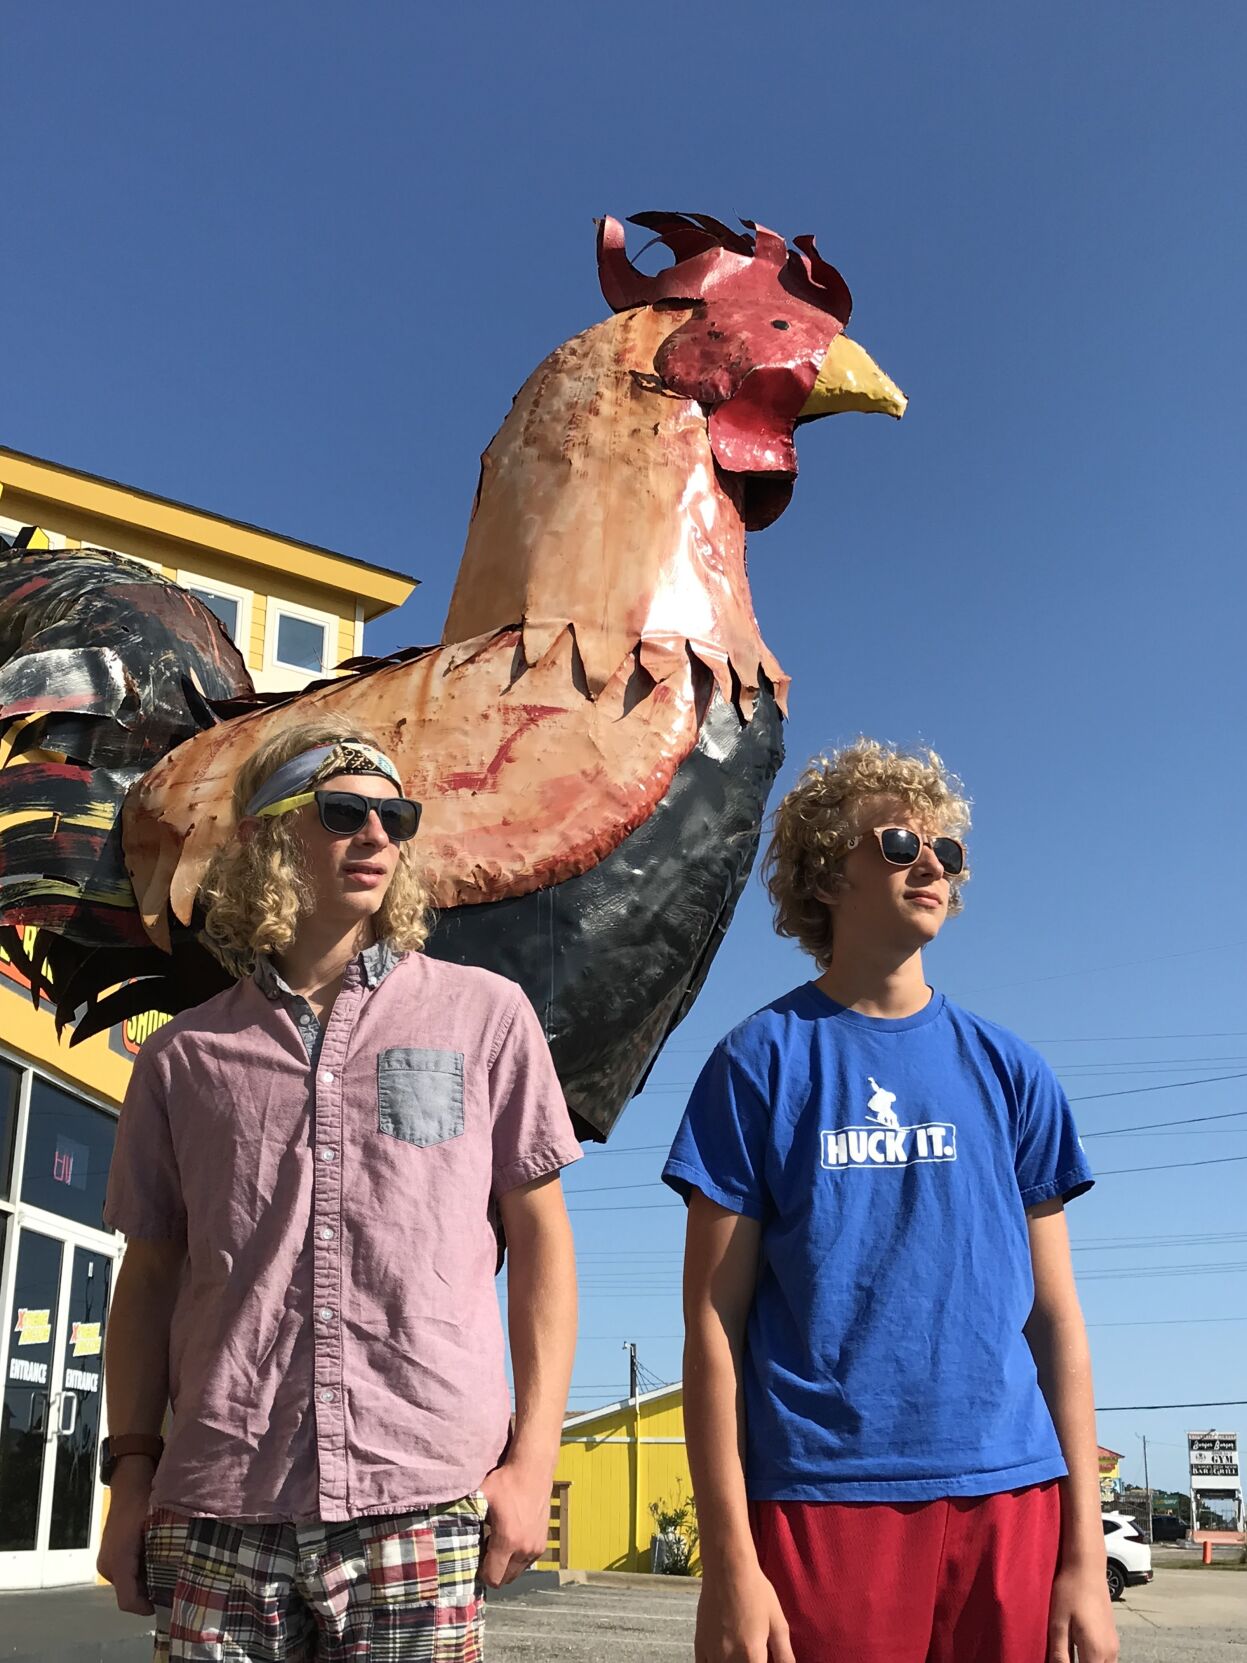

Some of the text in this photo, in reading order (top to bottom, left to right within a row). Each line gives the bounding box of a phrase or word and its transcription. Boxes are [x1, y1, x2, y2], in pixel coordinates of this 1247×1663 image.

[827, 1127, 954, 1164] HUCK IT.
[9, 1358, 48, 1384] ENTRANCE
[65, 1368, 99, 1392] ENTRANCE
[1211, 1455, 1233, 1464] GYM
